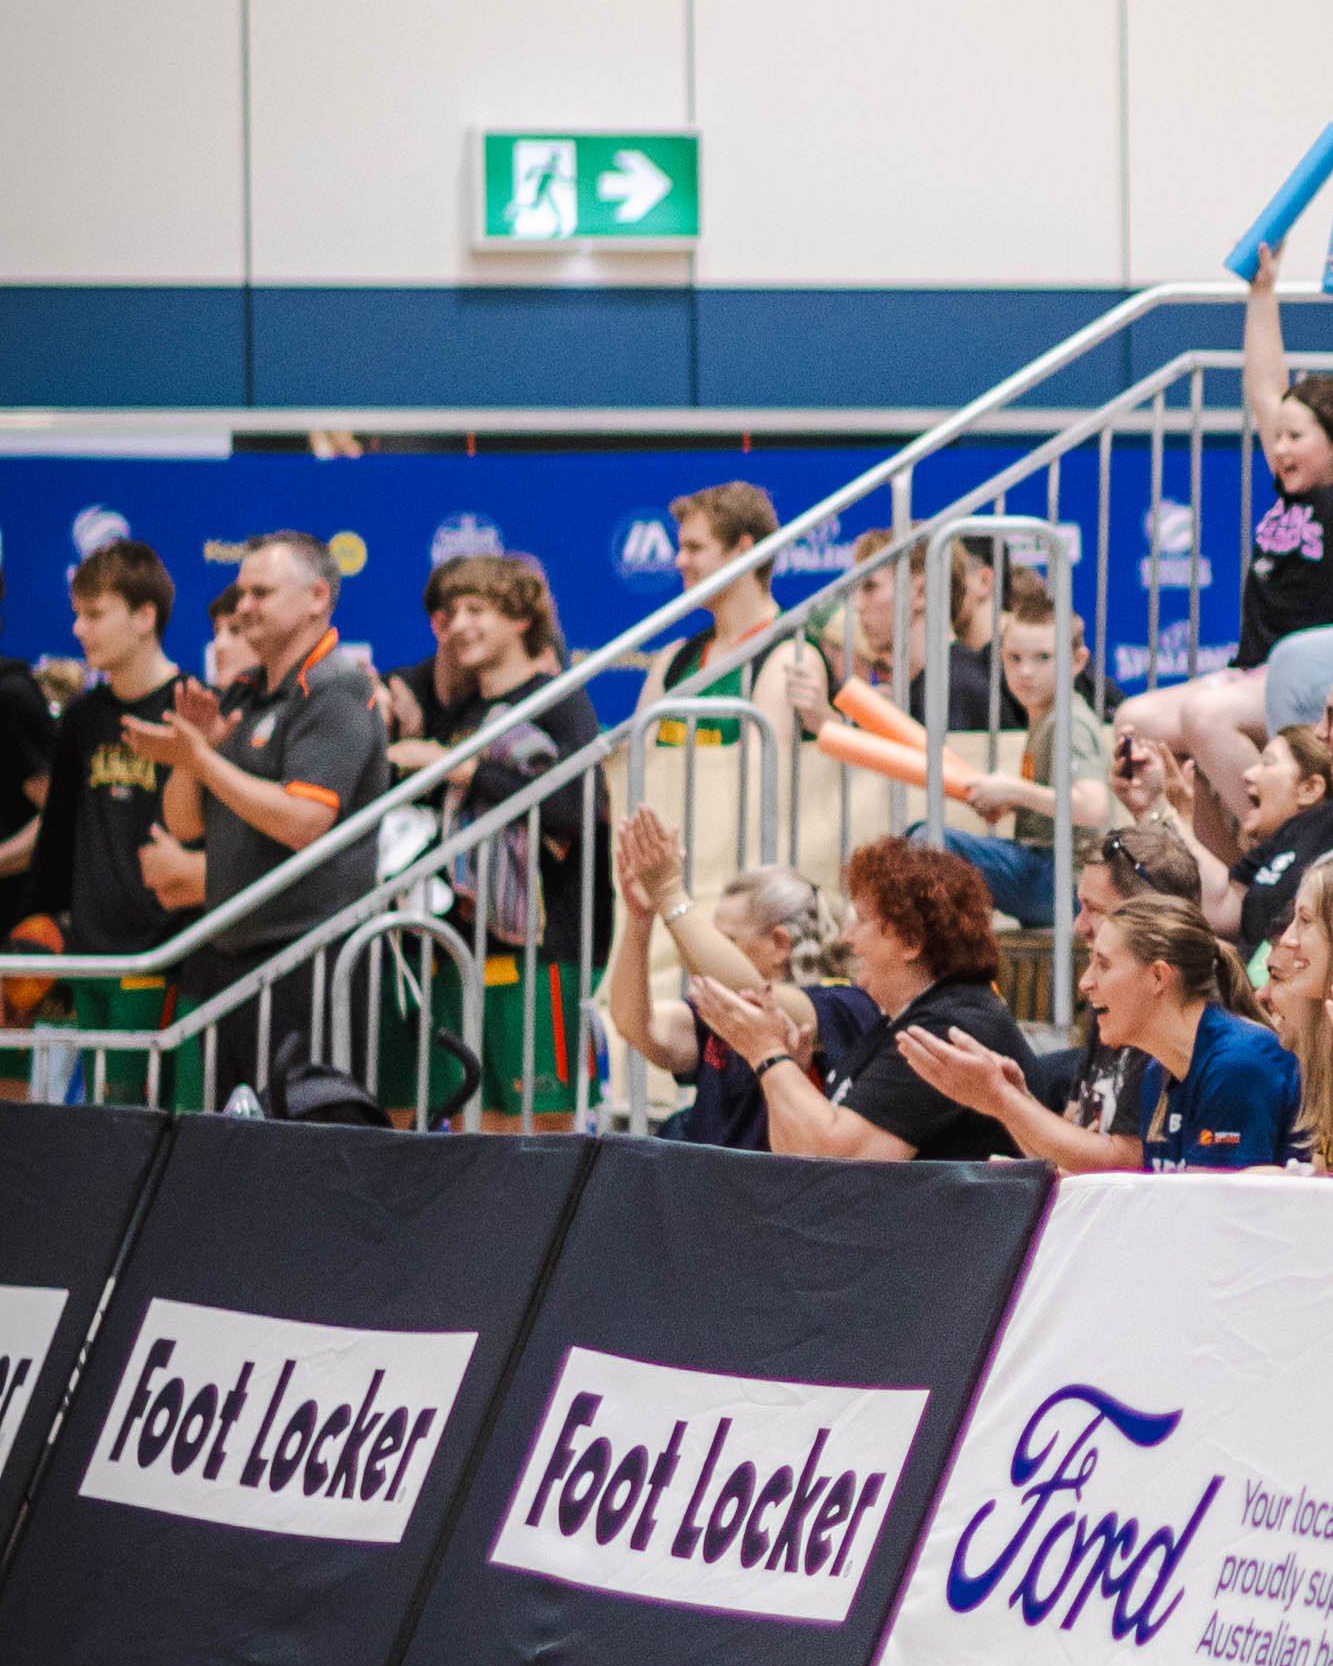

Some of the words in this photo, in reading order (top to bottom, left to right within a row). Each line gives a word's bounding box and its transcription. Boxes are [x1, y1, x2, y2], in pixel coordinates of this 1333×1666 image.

[109, 1338, 255, 1480] Foot
[239, 1358, 437, 1502] Locker
[525, 1391, 689, 1552] Foot
[670, 1417, 887, 1577] Locker
[946, 1383, 1226, 1646] Ford
[1213, 1552, 1306, 1613] proudly
[1241, 1478, 1293, 1531] Your
